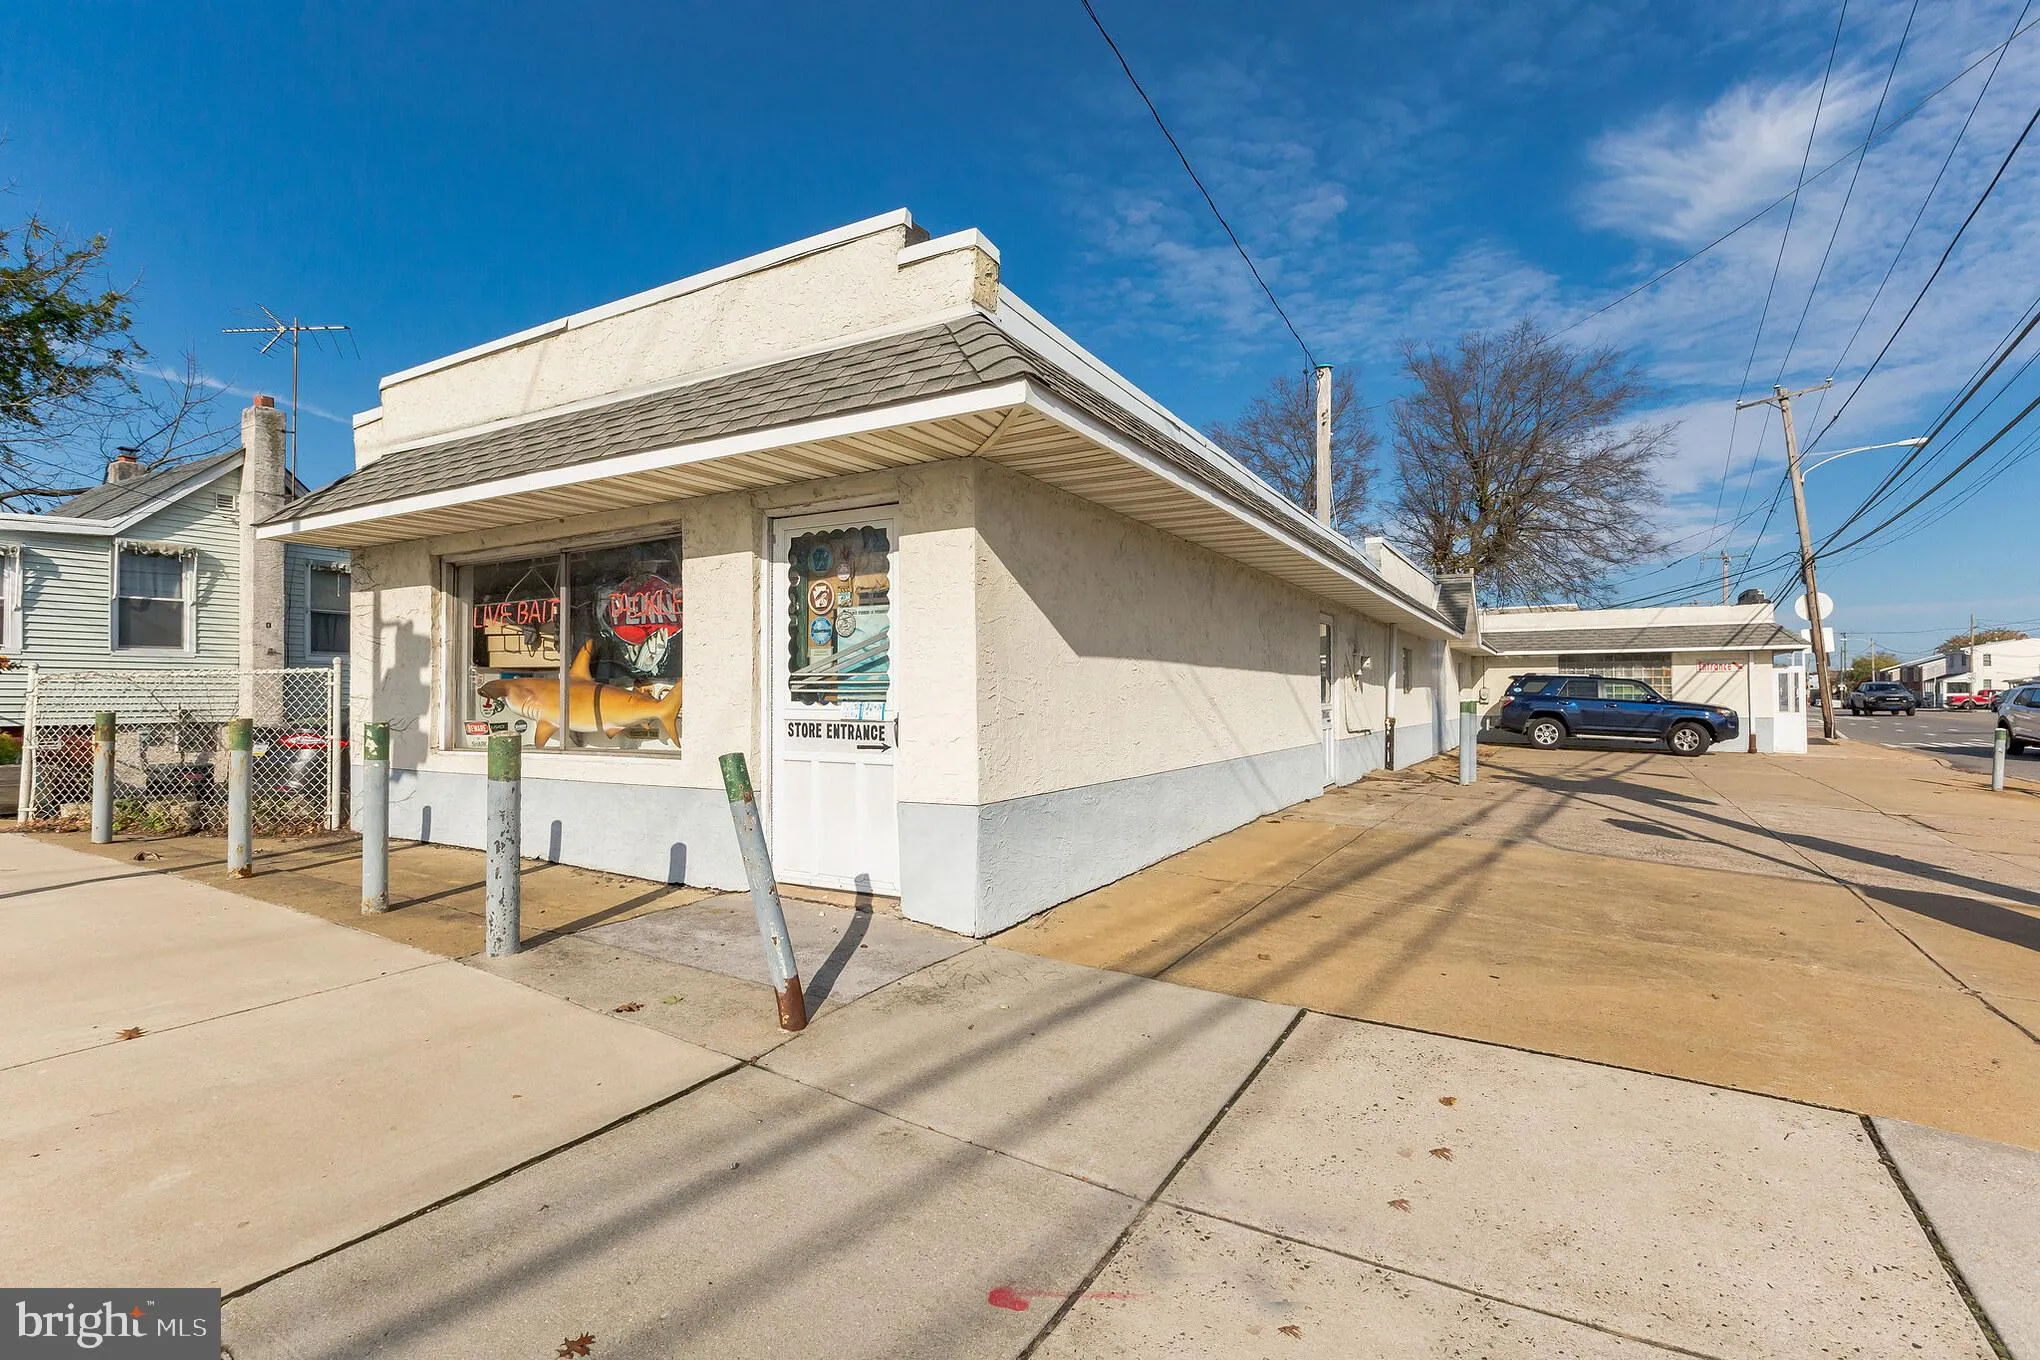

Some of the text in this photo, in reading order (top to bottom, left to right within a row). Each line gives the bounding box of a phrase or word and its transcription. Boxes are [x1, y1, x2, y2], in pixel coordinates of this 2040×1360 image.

[473, 598, 560, 629] LIVE BAIT
[788, 722, 885, 741] STORE ENTRANCE
